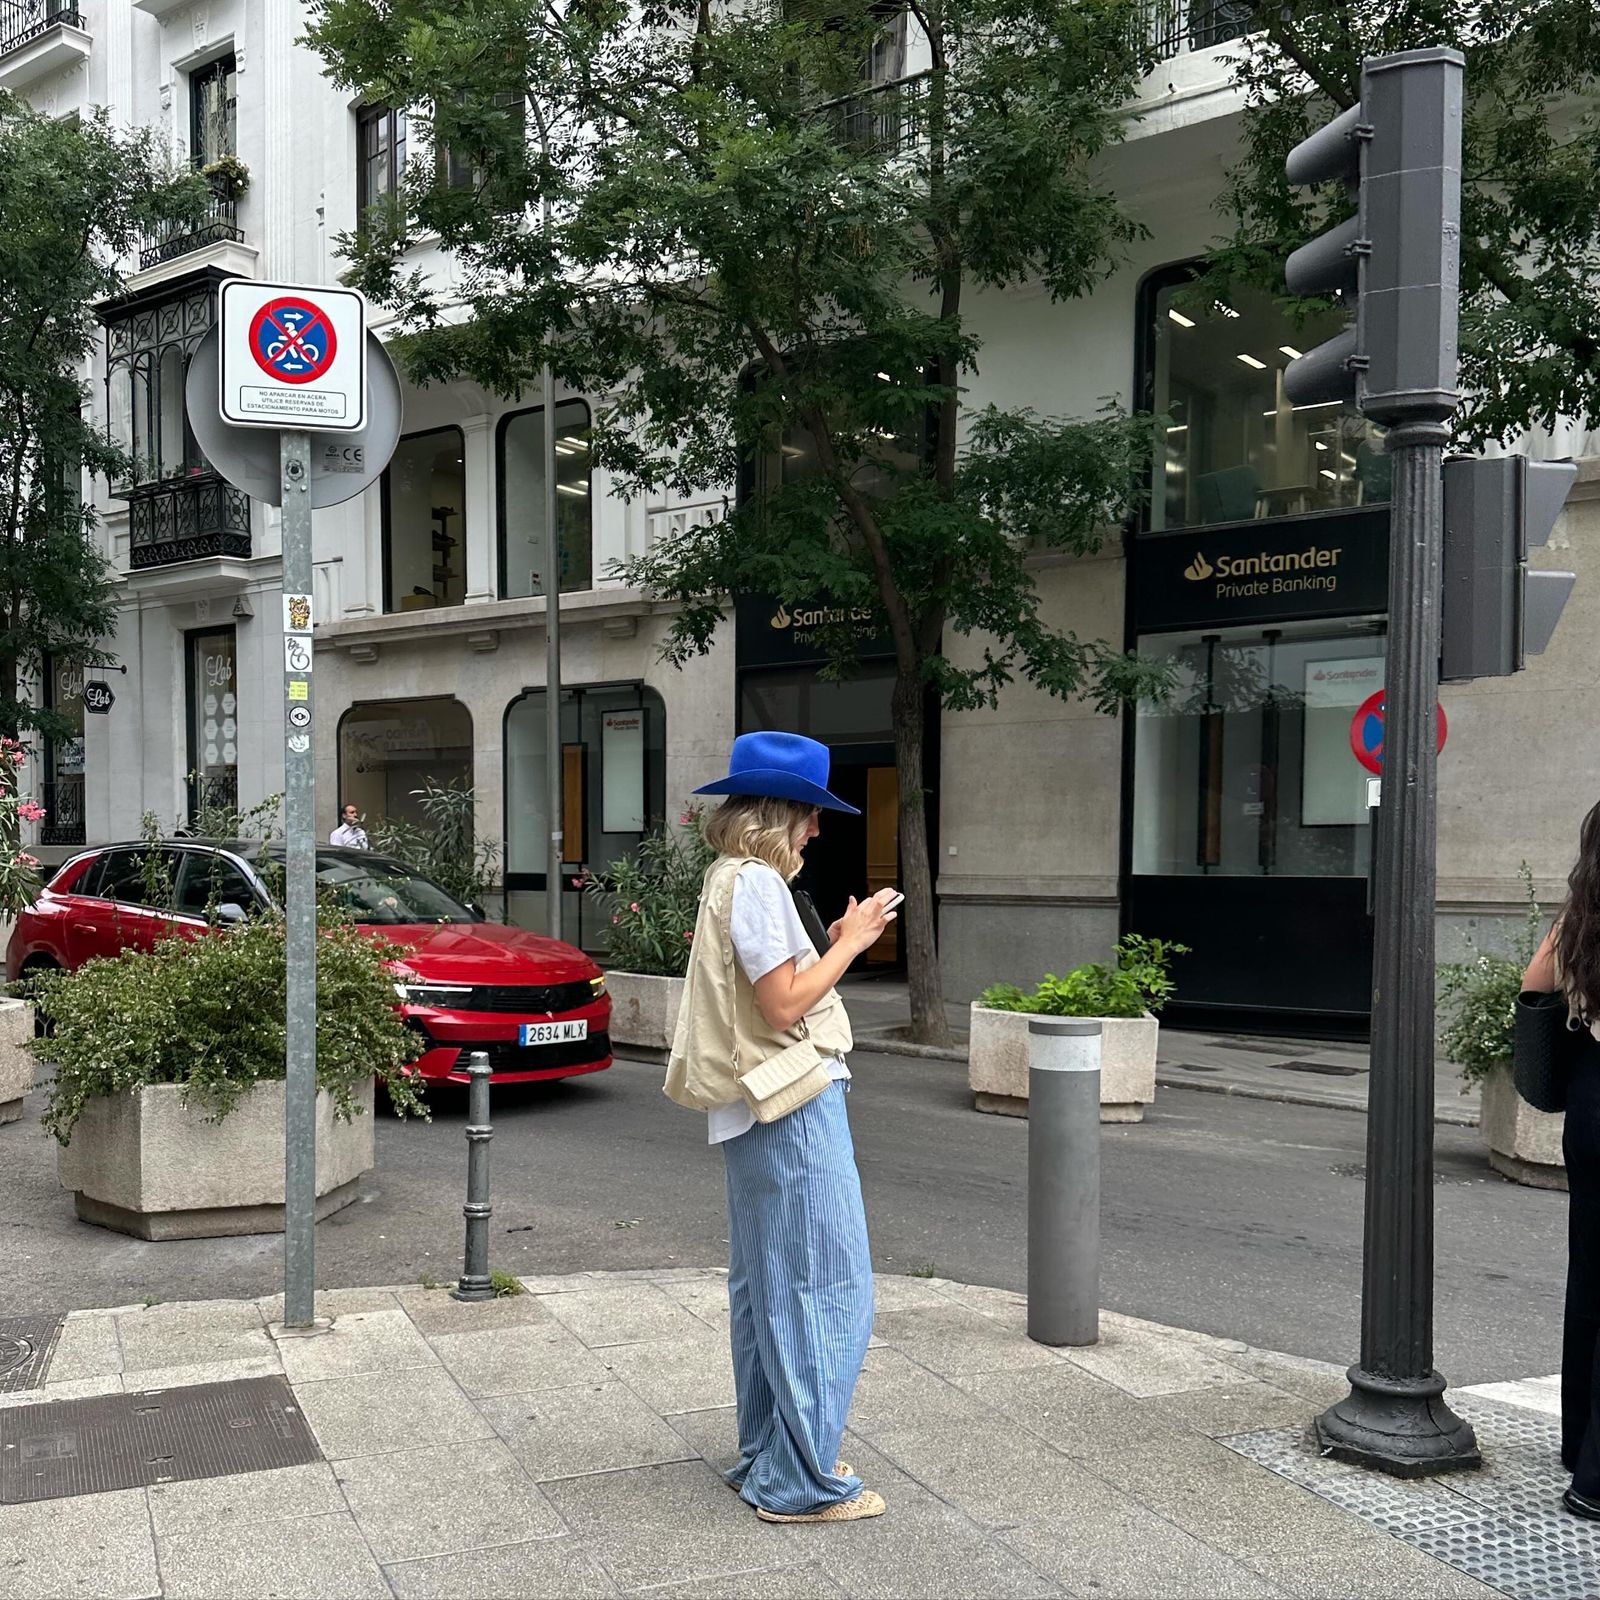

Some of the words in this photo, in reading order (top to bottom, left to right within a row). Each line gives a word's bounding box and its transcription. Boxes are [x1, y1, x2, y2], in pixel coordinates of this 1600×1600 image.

[247, 403, 301, 412] ESTACIONAMIENTO
[1216, 546, 1342, 578] Santander
[1216, 580, 1269, 599] Private
[1272, 575, 1337, 593] Banking
[1326, 668, 1378, 681] Santander
[529, 1025, 559, 1042] 2634
[563, 1023, 585, 1039] MLX
